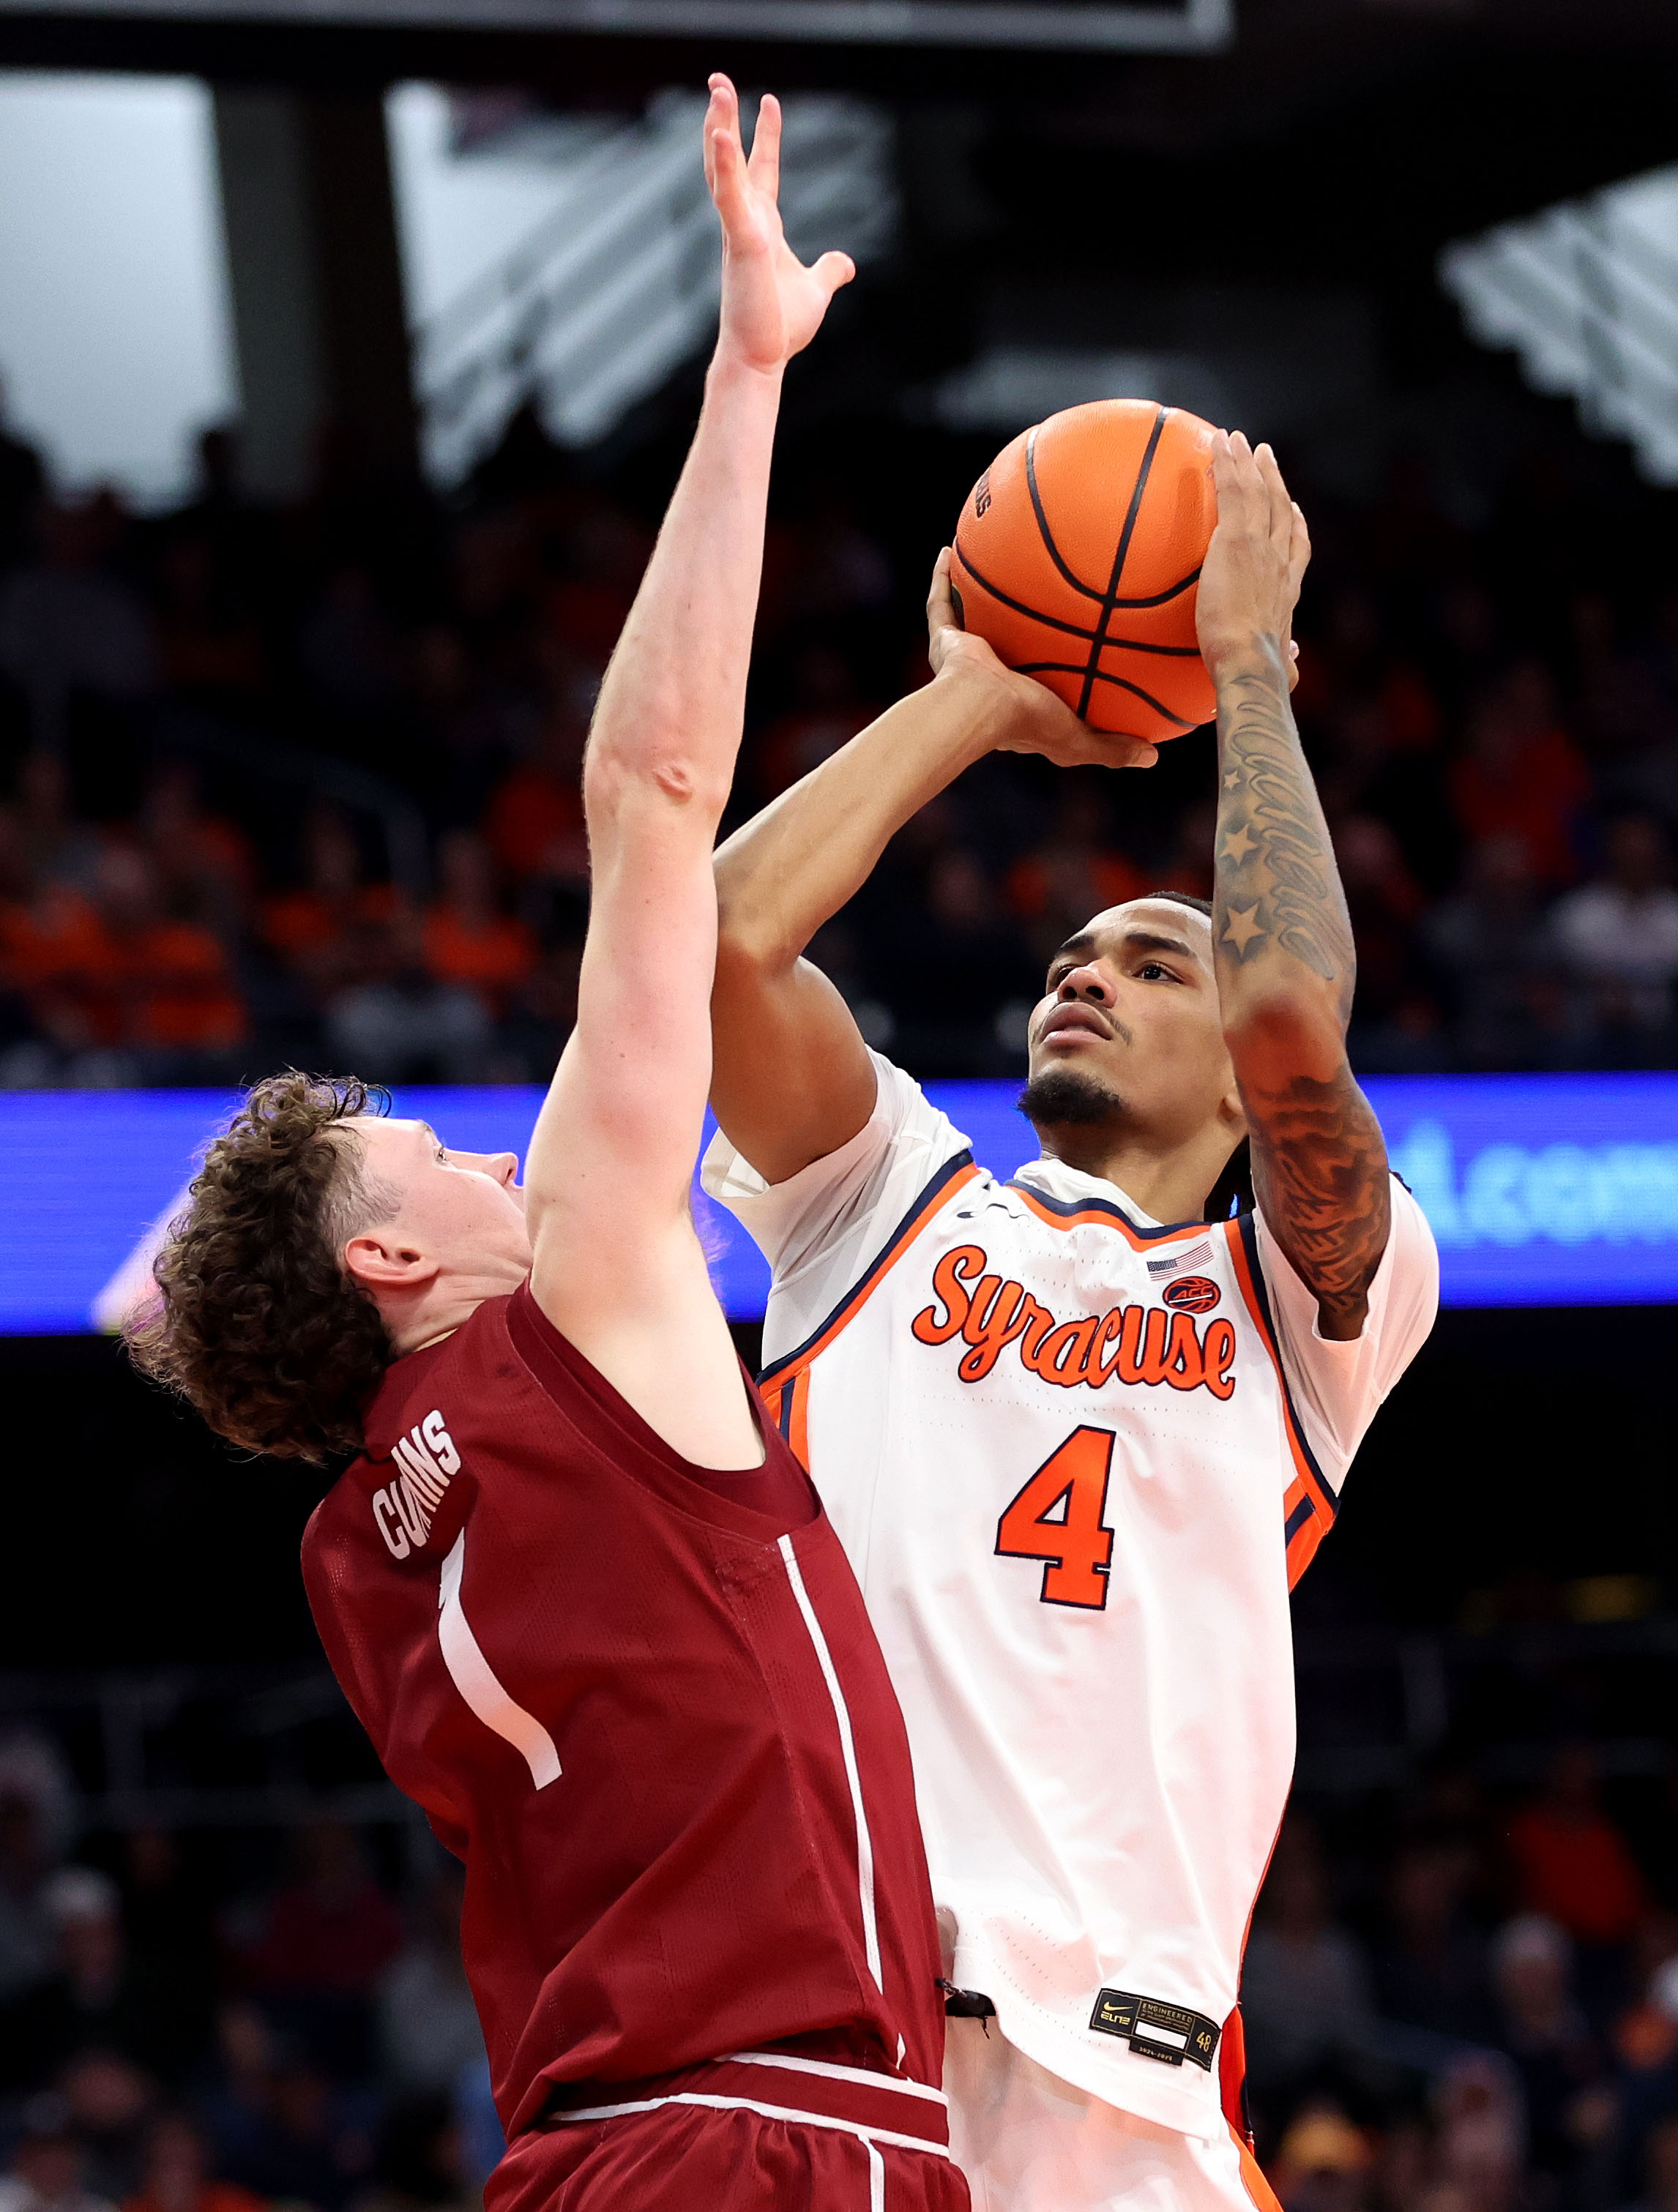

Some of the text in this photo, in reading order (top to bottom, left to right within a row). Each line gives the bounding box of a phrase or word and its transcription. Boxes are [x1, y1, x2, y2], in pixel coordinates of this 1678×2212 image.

[1173, 1285, 1213, 1300] ACC
[911, 1244, 1237, 1401] Syracuse
[373, 1410, 461, 1560] CUINS
[993, 1424, 1116, 1611] 4
[1100, 2011, 1131, 2025] ELITE
[1142, 2003, 1193, 2022] ENGINEERED
[1196, 2031, 1212, 2052] 48
